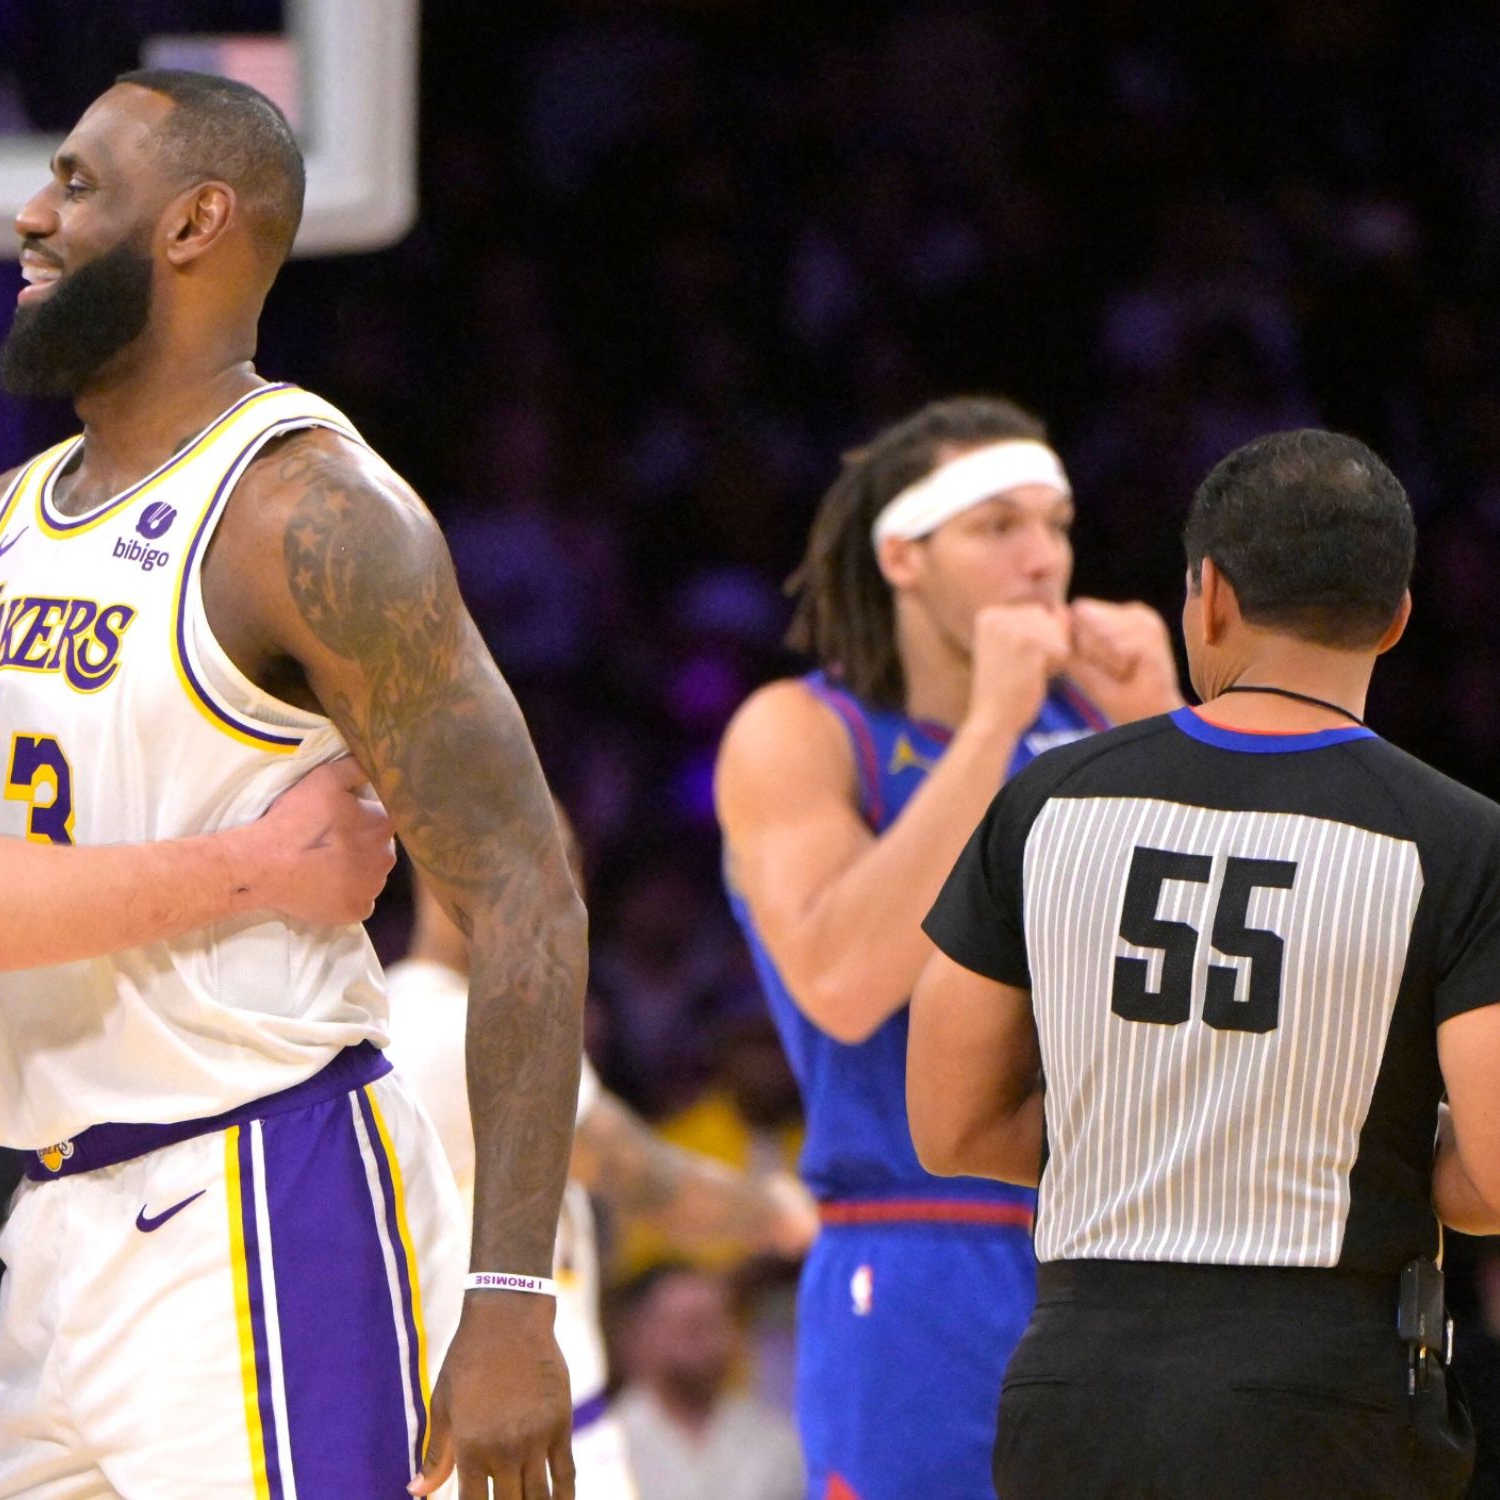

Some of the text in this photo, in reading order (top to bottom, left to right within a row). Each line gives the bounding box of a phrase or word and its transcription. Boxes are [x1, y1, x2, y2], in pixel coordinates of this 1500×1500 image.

[112, 536, 170, 572] bibigo
[1110, 845, 1299, 1035] 55
[475, 1275, 534, 1289] PROMISE
